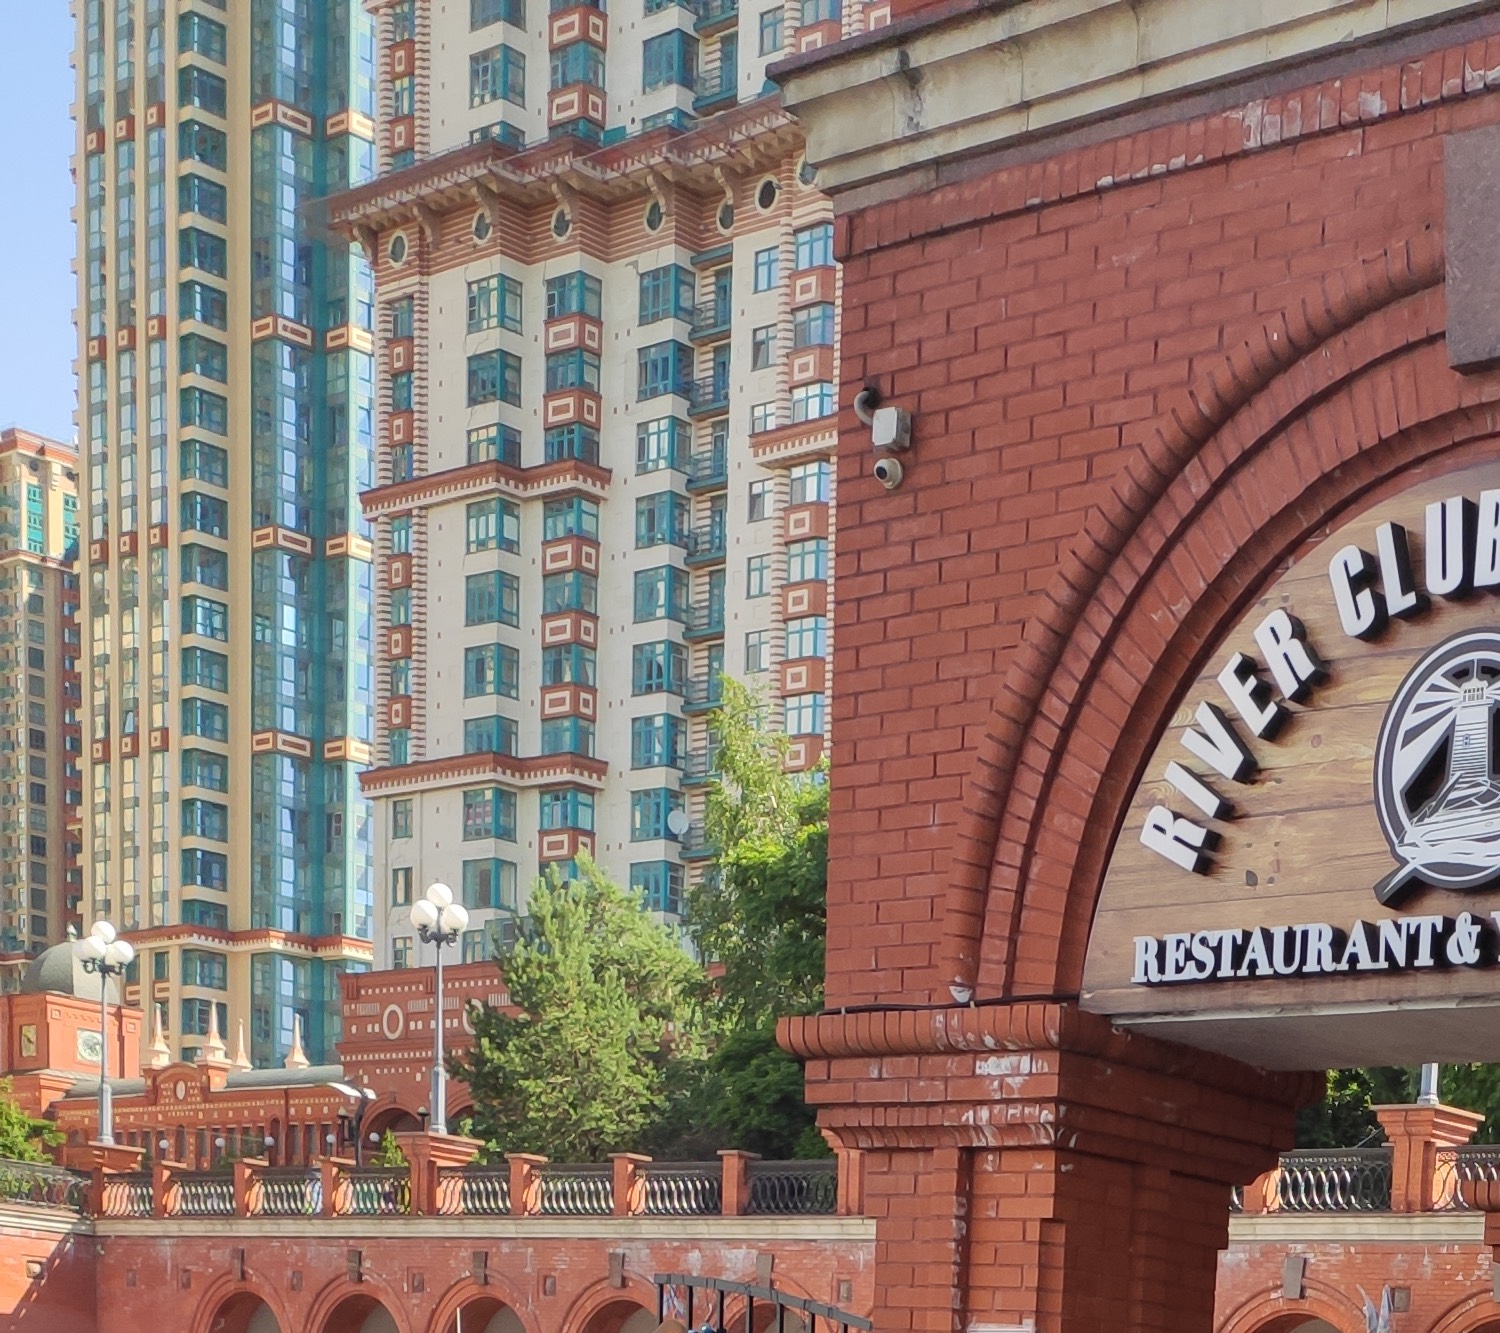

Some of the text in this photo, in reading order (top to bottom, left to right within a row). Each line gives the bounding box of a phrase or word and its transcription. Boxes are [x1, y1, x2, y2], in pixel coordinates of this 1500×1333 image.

[1139, 607, 1320, 873] RIVER
[1130, 914, 1444, 984] RESTAURANT
[1446, 911, 1482, 966] &
